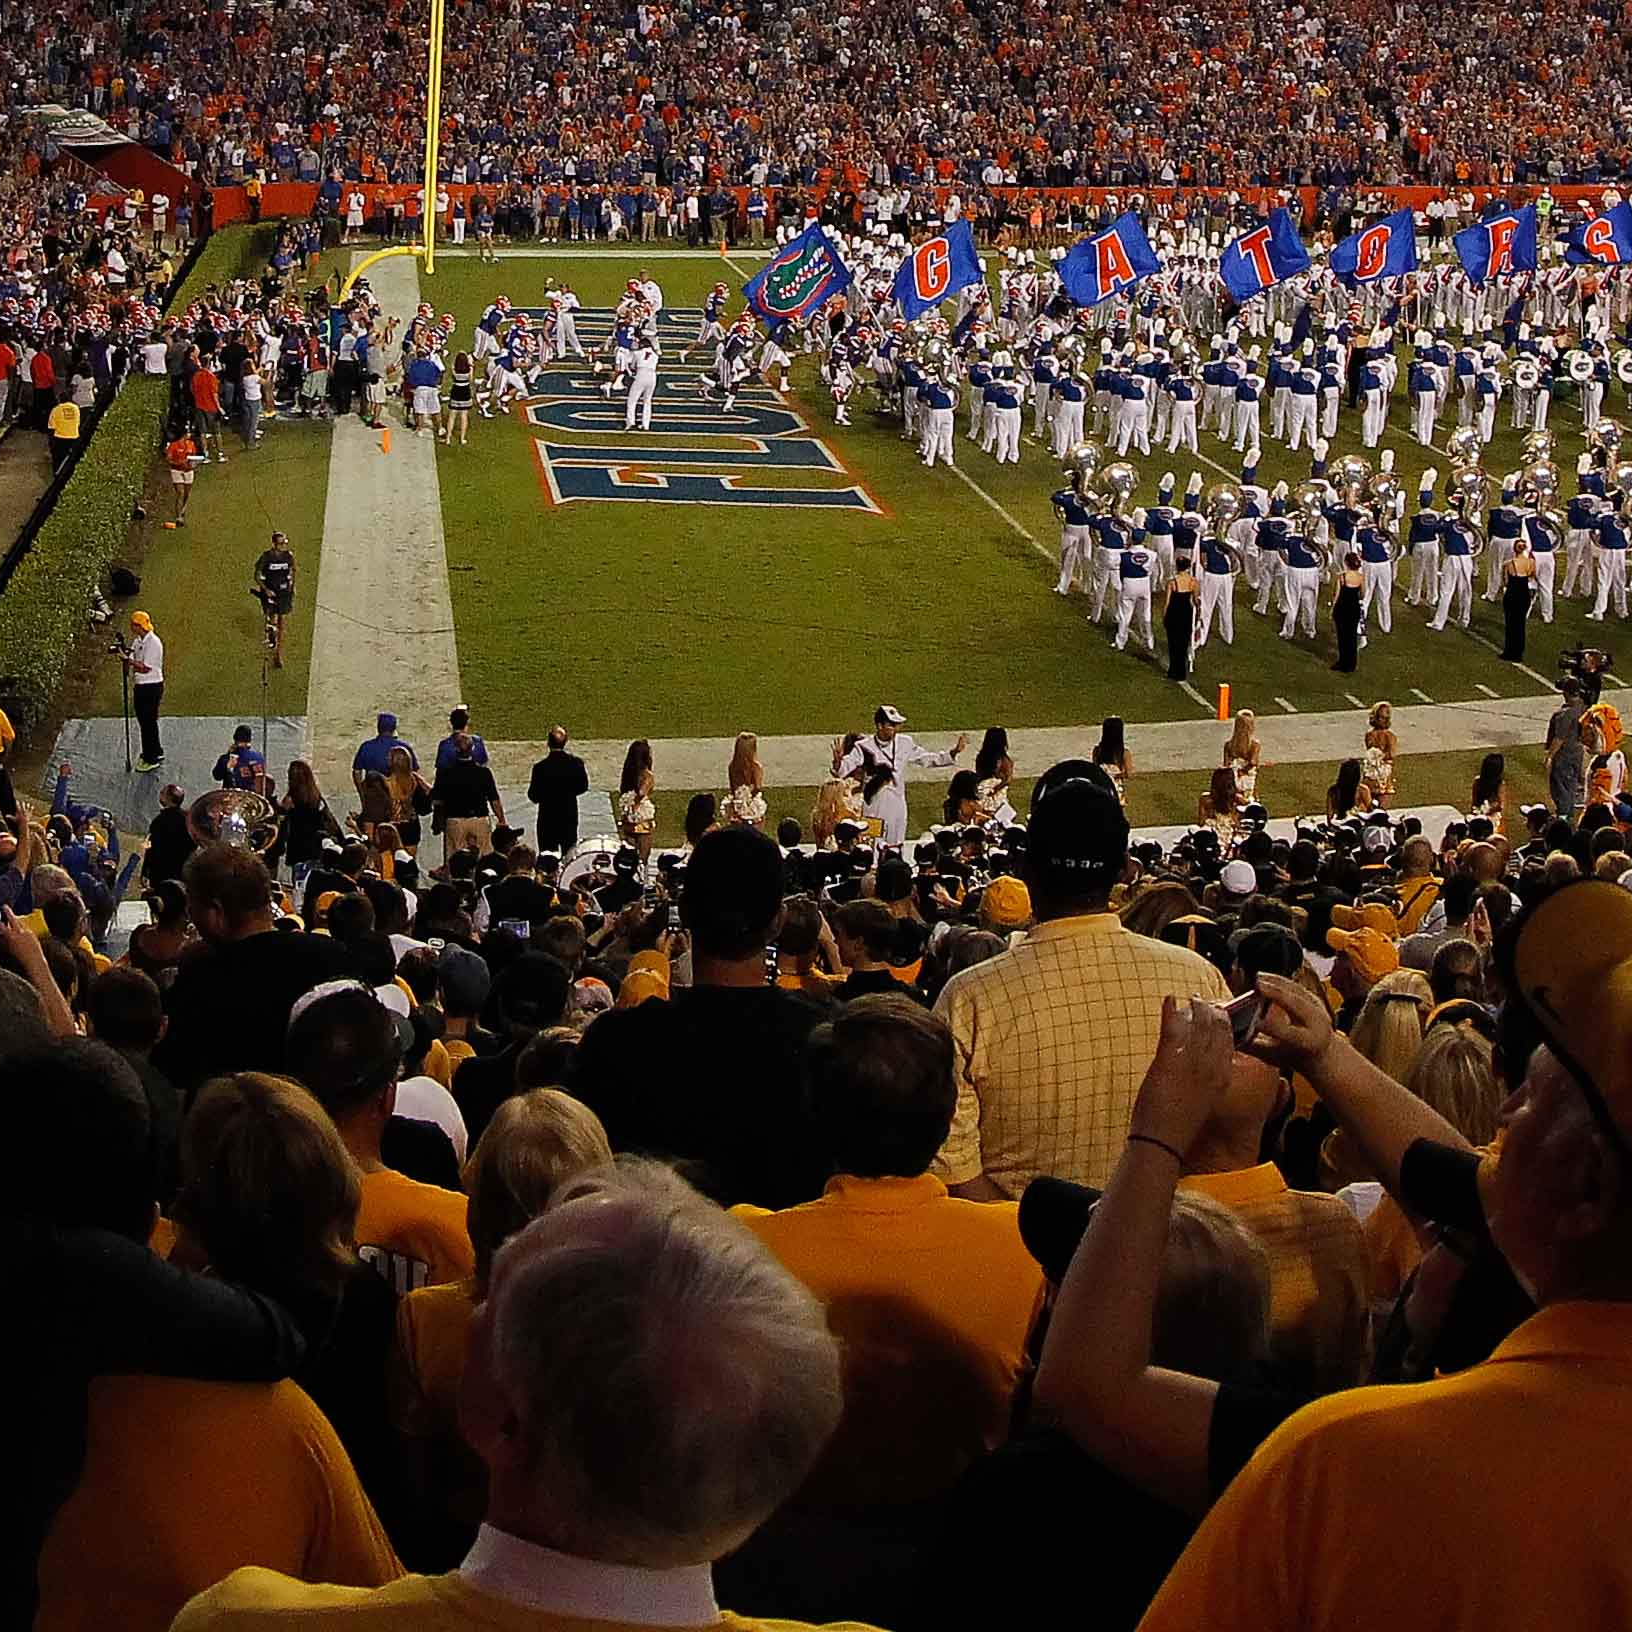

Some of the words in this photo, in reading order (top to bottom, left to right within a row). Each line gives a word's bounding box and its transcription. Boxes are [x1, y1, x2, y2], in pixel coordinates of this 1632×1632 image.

[912, 235, 952, 303] G
[1096, 229, 1137, 301] A
[1236, 224, 1281, 288] T
[1353, 223, 1393, 281] O
[1483, 216, 1521, 280] R
[1583, 217, 1621, 264] S
